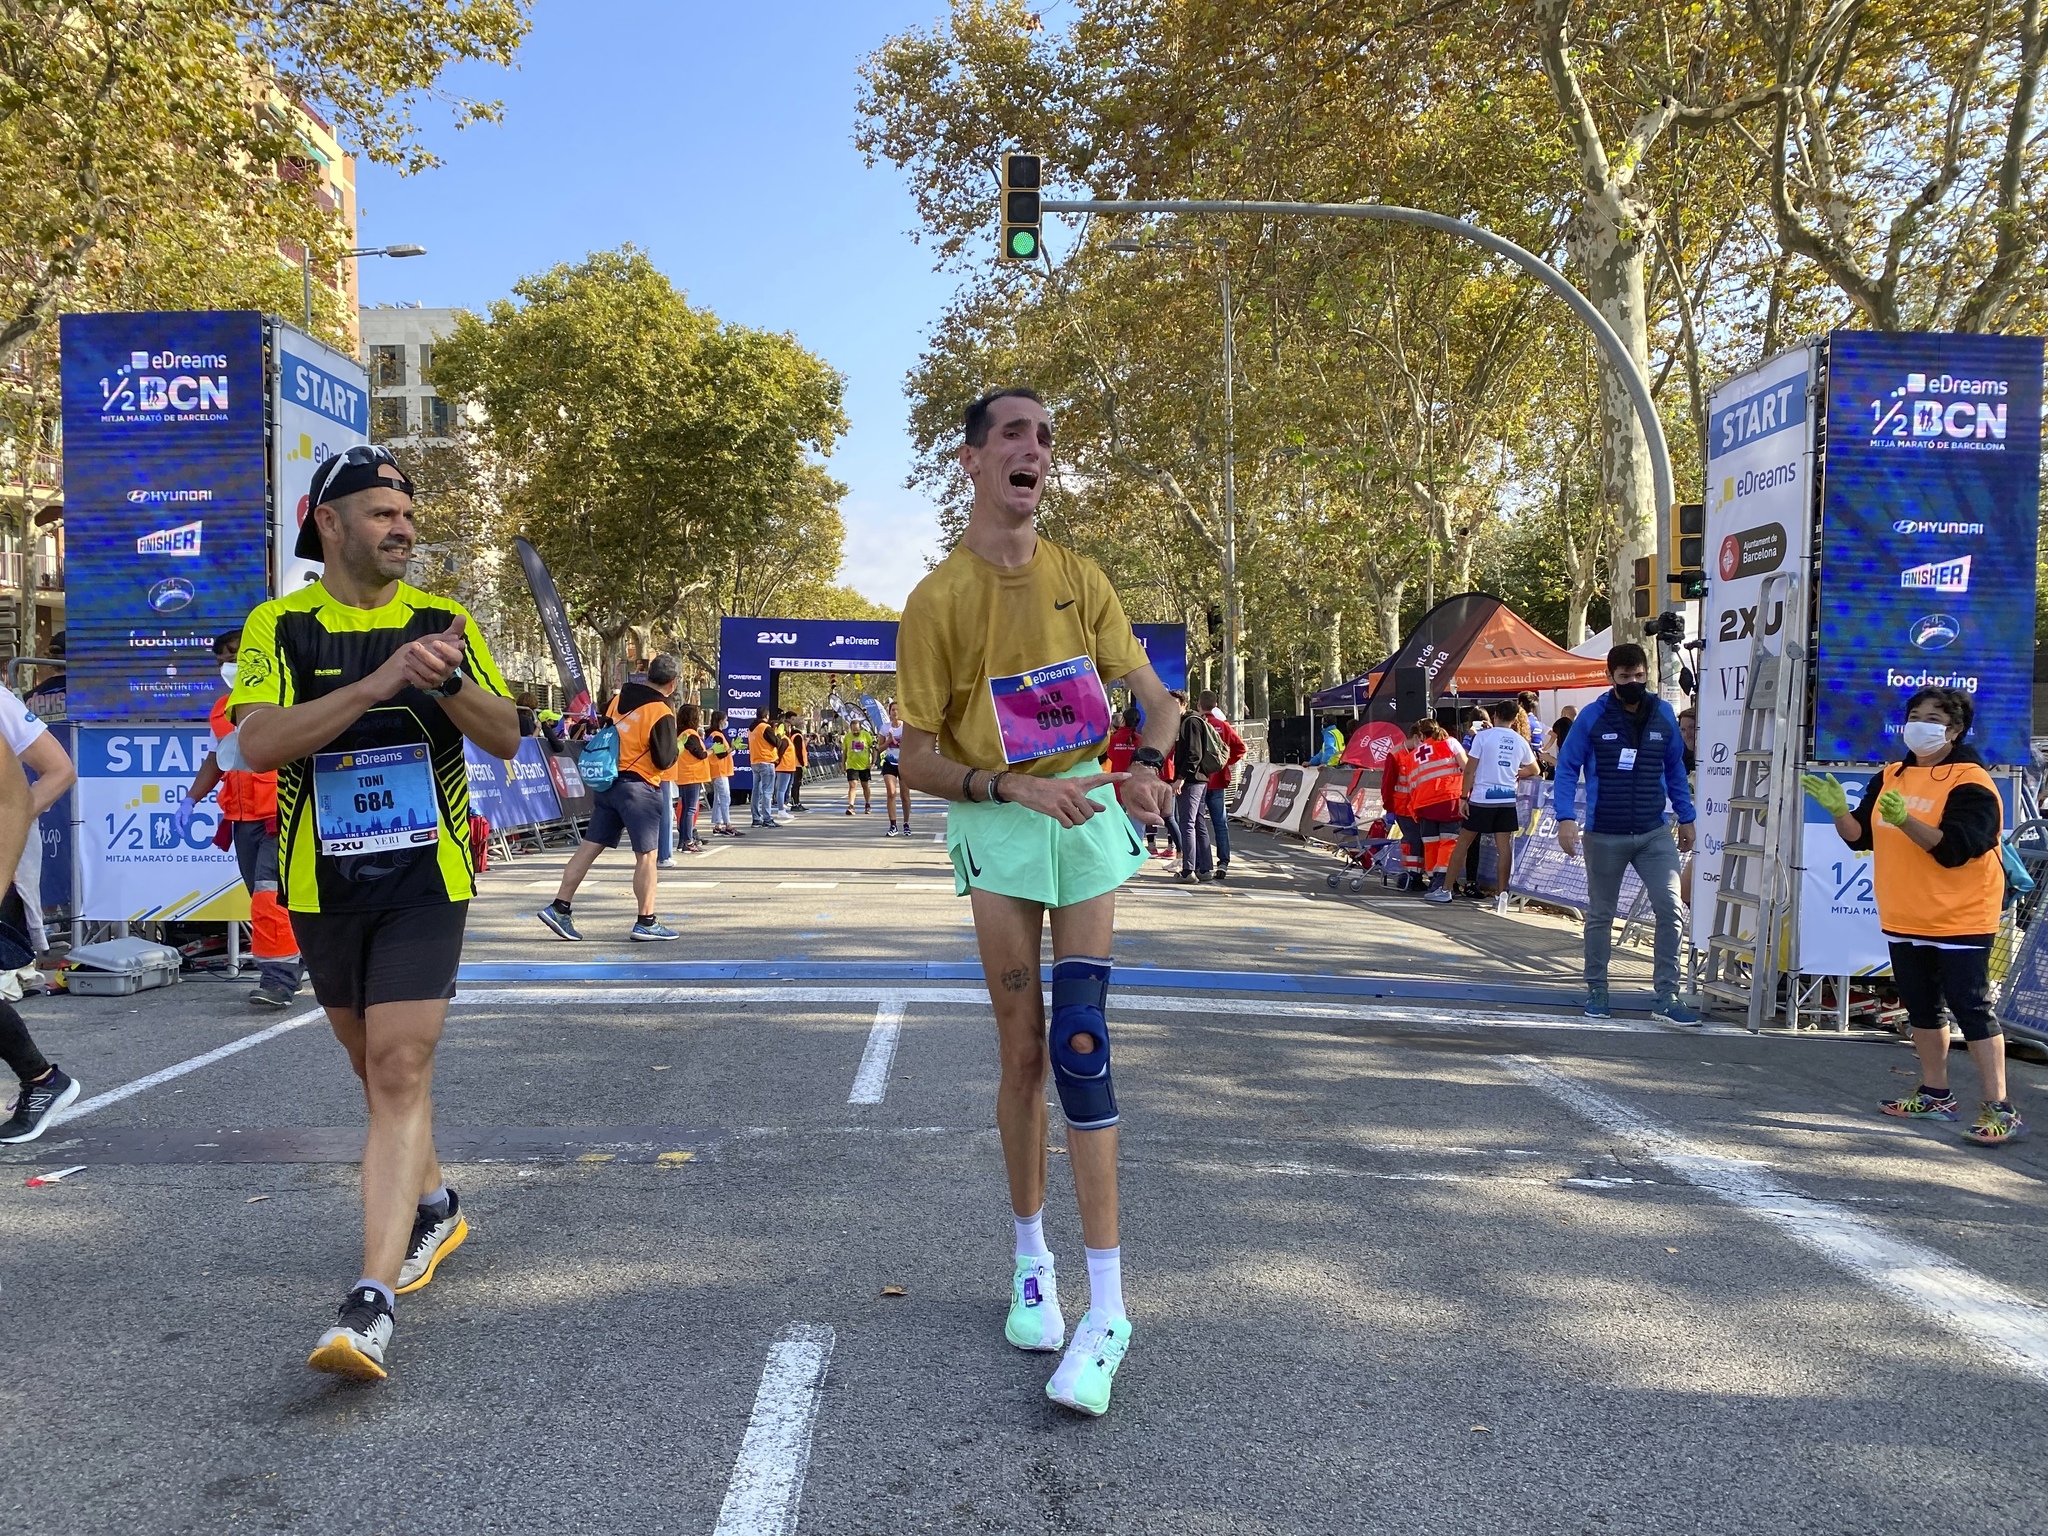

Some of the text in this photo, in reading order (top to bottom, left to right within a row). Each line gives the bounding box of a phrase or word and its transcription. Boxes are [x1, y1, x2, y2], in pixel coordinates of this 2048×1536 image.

[152, 351, 227, 369] eDreams
[1929, 374, 2008, 395] eDreams
[140, 376, 228, 411] BCN
[296, 365, 358, 425] START
[101, 413, 229, 422] MITJA MARATÓ DE BARCELONA
[1722, 384, 1794, 448] START
[1913, 400, 2007, 438] BCN
[1870, 440, 2005, 450] MITJA MARATÓ DE BARCELONA
[1737, 462, 1796, 498] eDreams
[151, 490, 212, 501] HYUNDAI
[1918, 522, 1984, 534] HYUNDAI
[140, 529, 195, 552] FINISHER
[1743, 534, 1778, 551] Ajuntament de
[1742, 546, 1777, 565] Barcelona
[1903, 564, 1963, 585] FINISHER
[1719, 601, 1783, 642] 2XU
[757, 632, 798, 644] 2XU
[845, 636, 880, 646] eDreams
[1422, 644, 1435, 657] de
[780, 660, 799, 668] THE
[804, 661, 834, 669] FIRST
[1033, 665, 1077, 685] eDreams
[1719, 665, 1749, 701] VE
[1887, 668, 1978, 694] foodspring
[727, 688, 761, 700] Cityscoot
[1040, 690, 1064, 706] ALEX
[729, 708, 756, 717] SANYTO
[1036, 705, 1076, 731] 986
[1077, 739, 1092, 747] FIRST
[355, 752, 402, 766] eDreams
[465, 759, 496, 782] Dreams
[512, 759, 546, 781] eDreams
[1707, 766, 1732, 776] HYUNDAI
[357, 774, 384, 788] TONI
[353, 790, 395, 814] 684
[1713, 802, 1730, 813] ZURI
[150, 812, 224, 850] BC
[331, 836, 400, 852] 2XU VERI
[105, 853, 239, 863] MITJA MARATÓ DE BARCELO
[1703, 872, 1720, 882] COMP
[1831, 906, 1860, 915] MITJA
